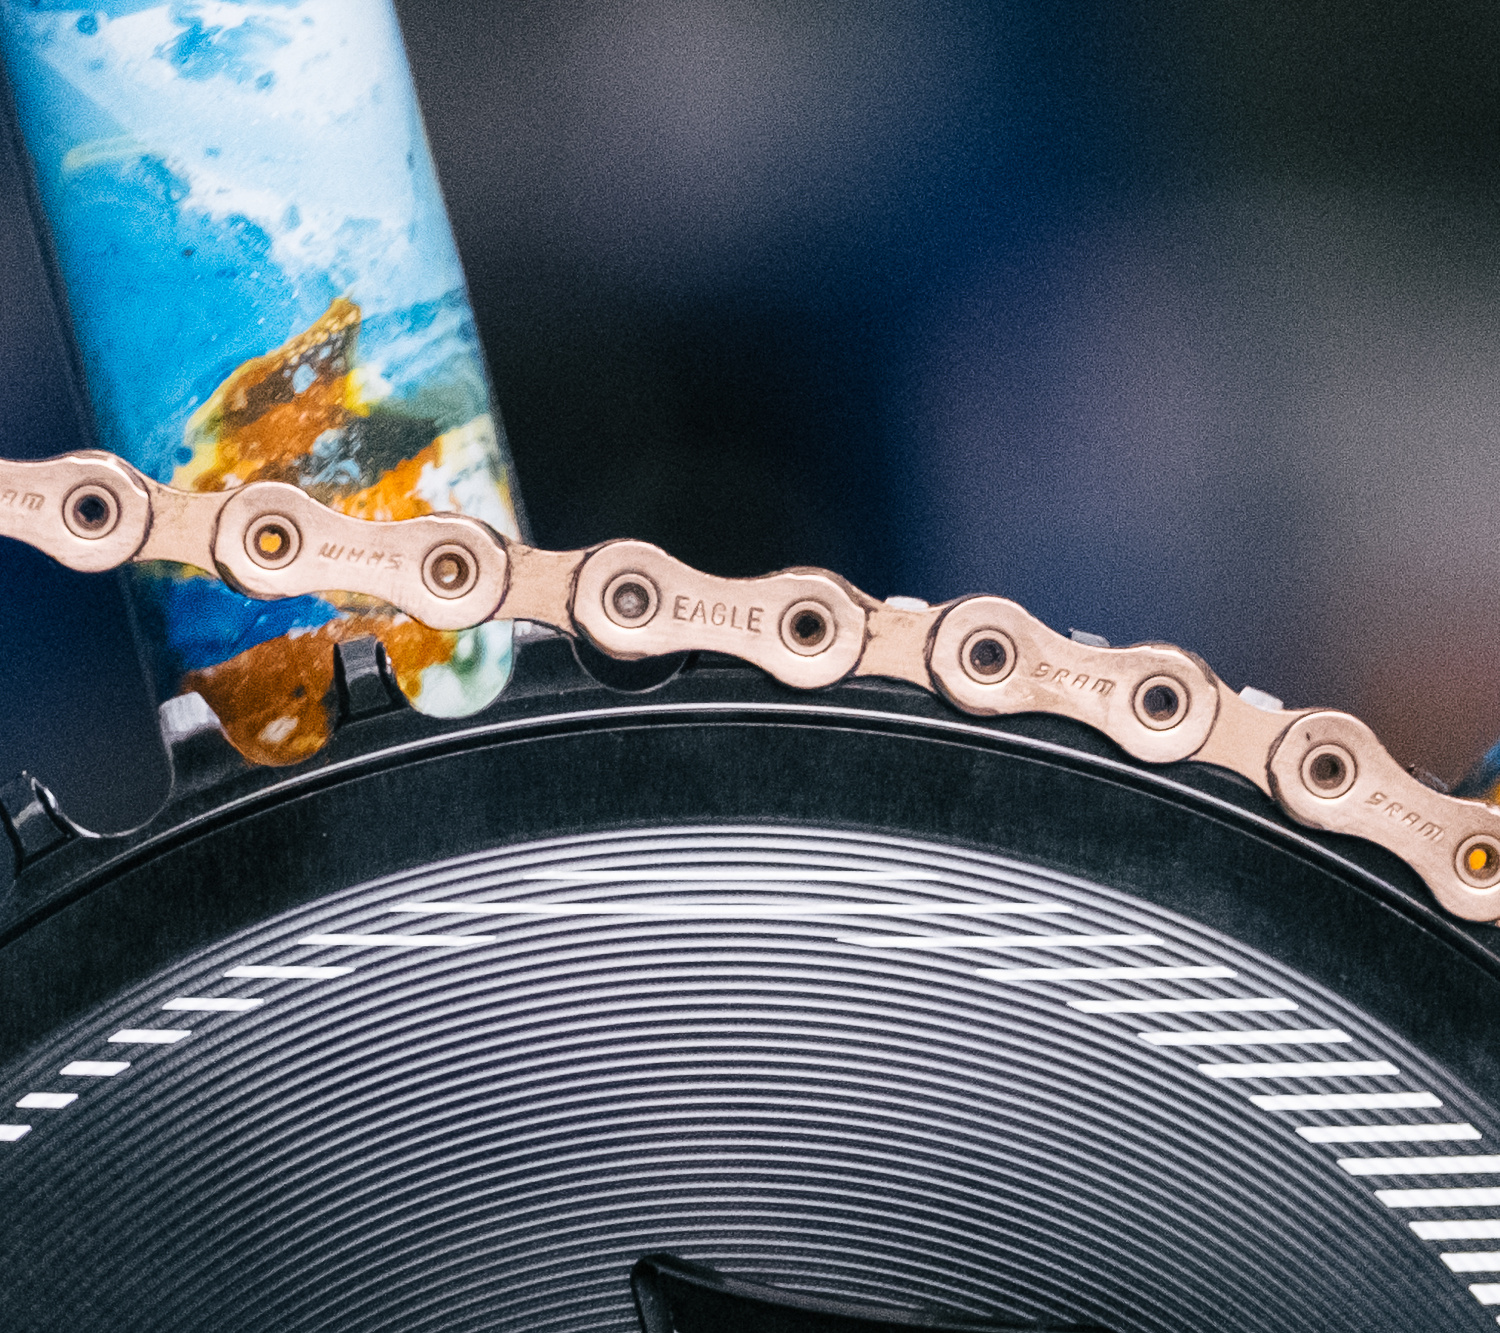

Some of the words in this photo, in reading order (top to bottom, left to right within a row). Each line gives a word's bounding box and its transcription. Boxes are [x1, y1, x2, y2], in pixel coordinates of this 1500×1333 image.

[672, 594, 765, 633] EAGLE
[1030, 661, 1117, 698] SRAM
[1366, 791, 1445, 842] SRAM
